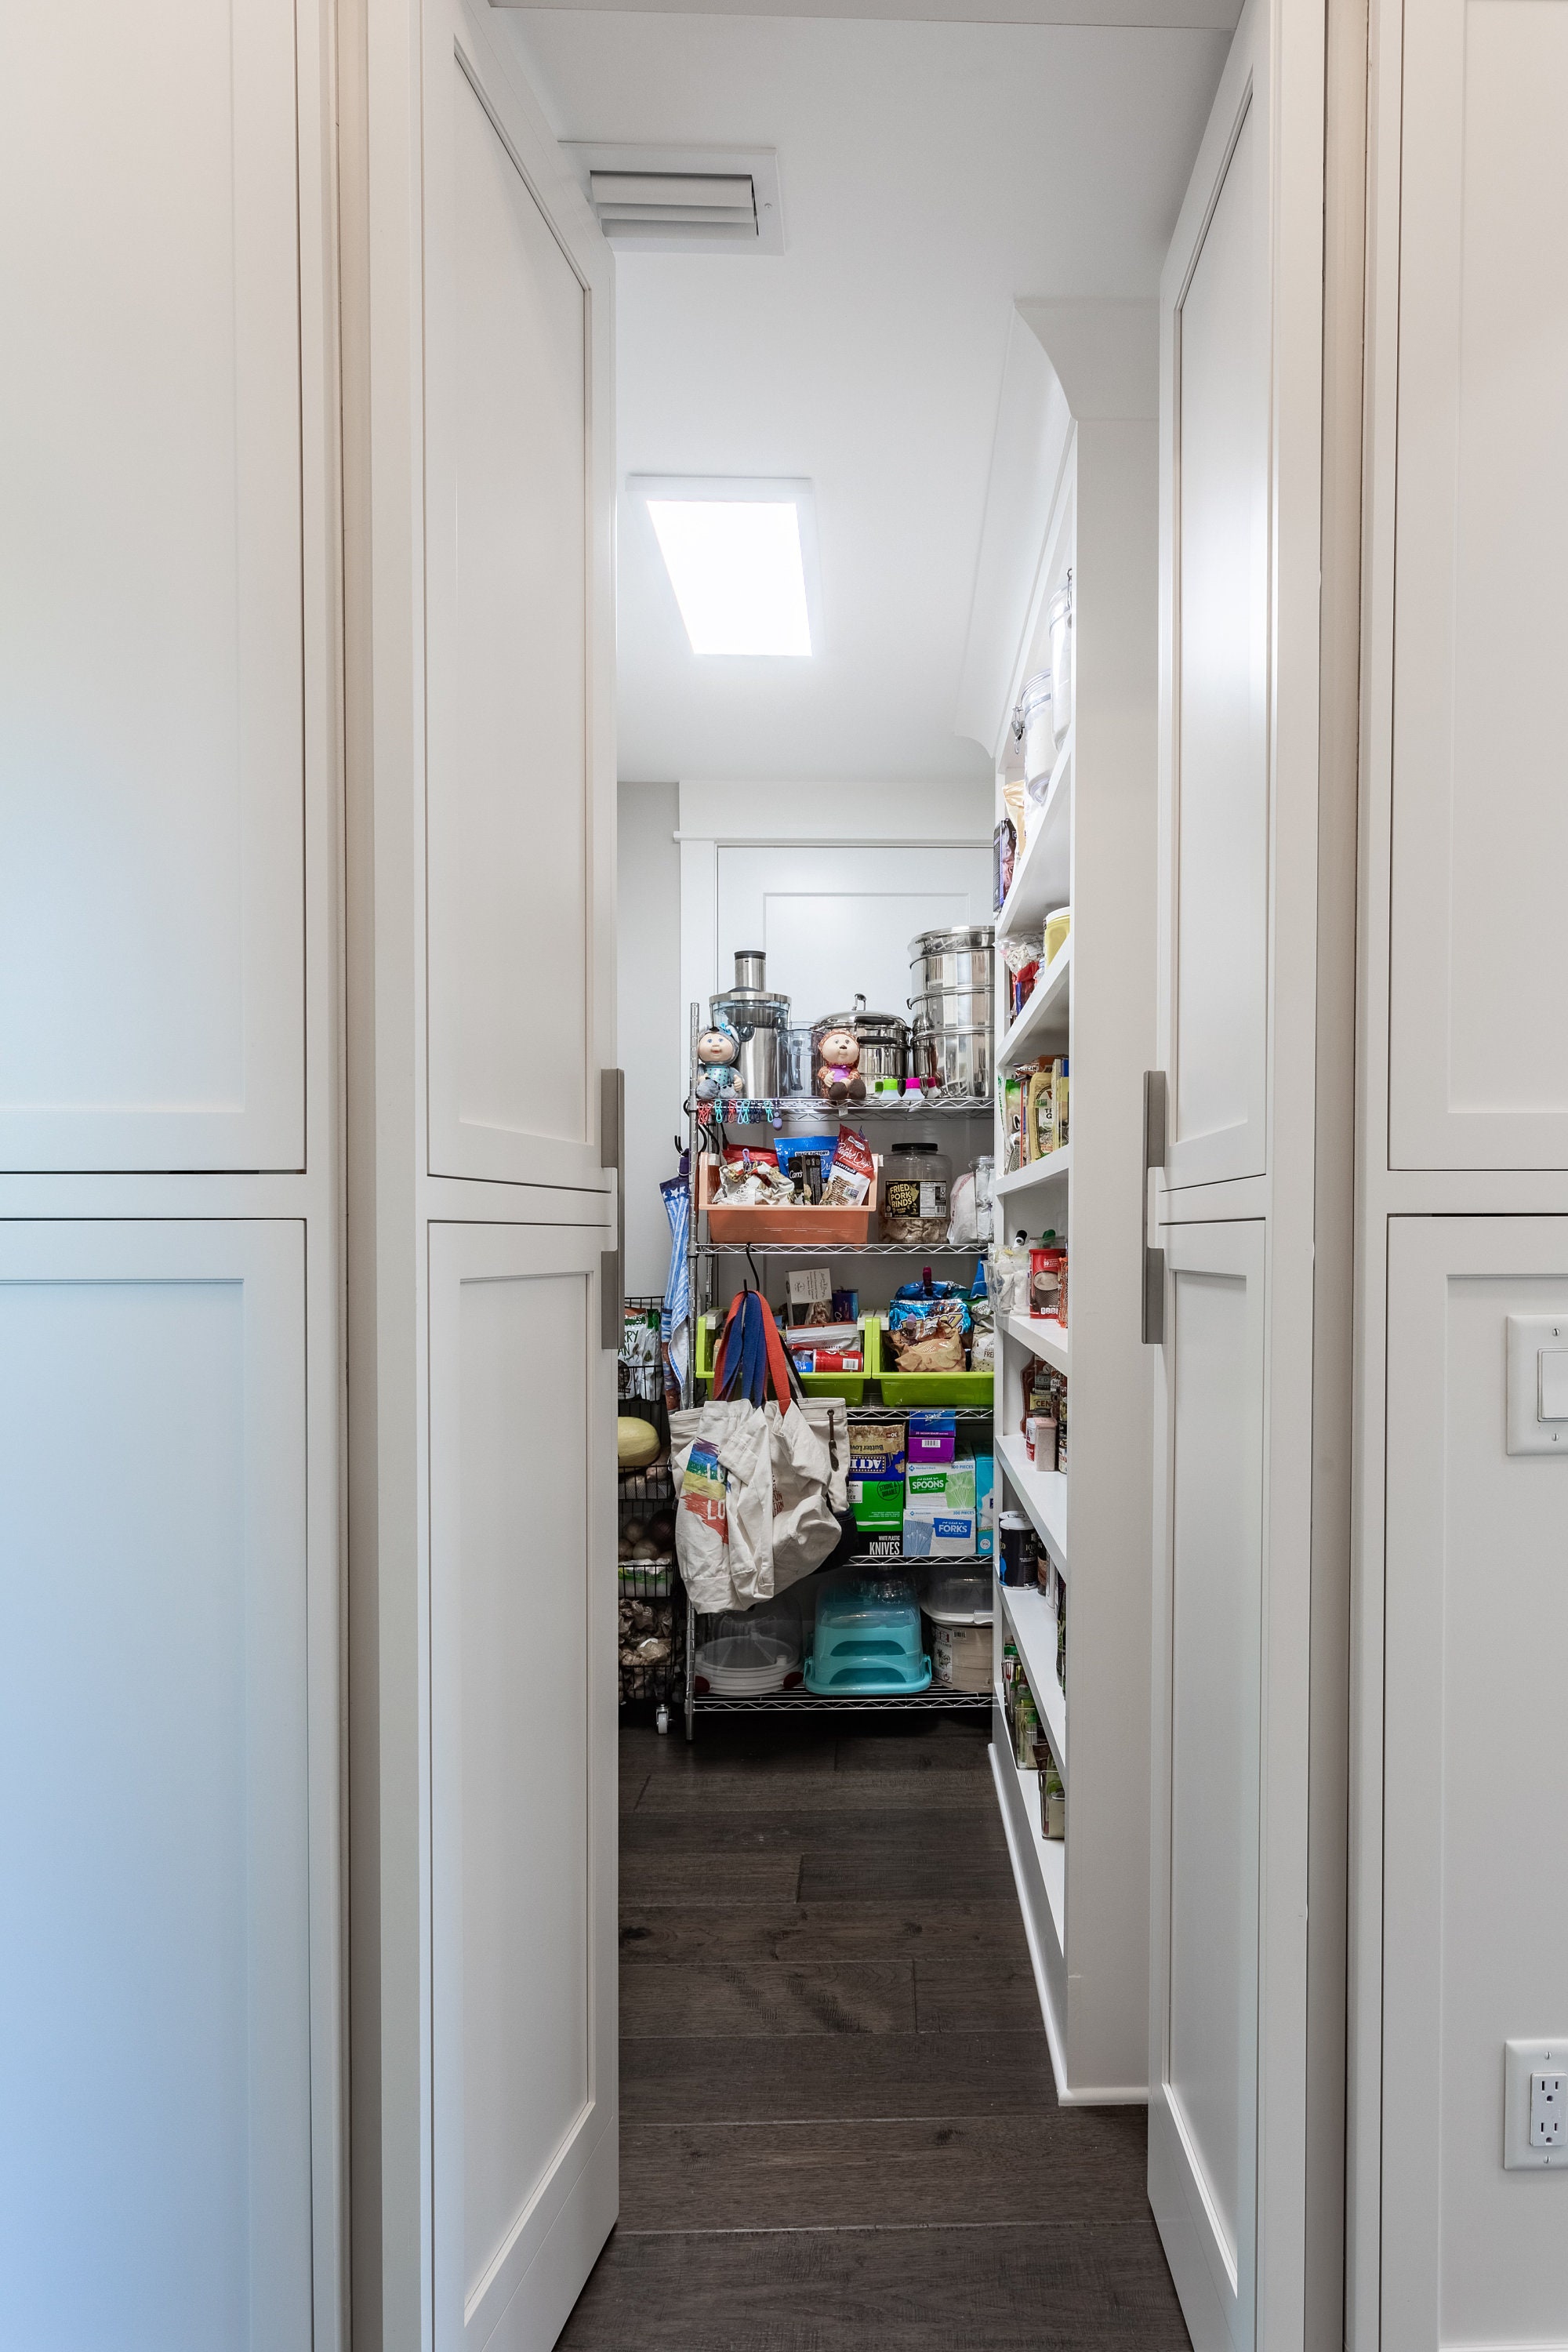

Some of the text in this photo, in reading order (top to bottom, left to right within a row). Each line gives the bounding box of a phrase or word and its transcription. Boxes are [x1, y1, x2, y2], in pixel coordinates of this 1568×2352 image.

[890, 1183, 910, 1194] FRIED
[891, 1192, 912, 1201] PORK
[891, 1198, 913, 1208] RINDS
[858, 1459, 881, 1469] ACT
[912, 1480, 944, 1490] SPOONS
[938, 1524, 967, 1533] FORKS
[869, 1541, 900, 1555] KNIVES
